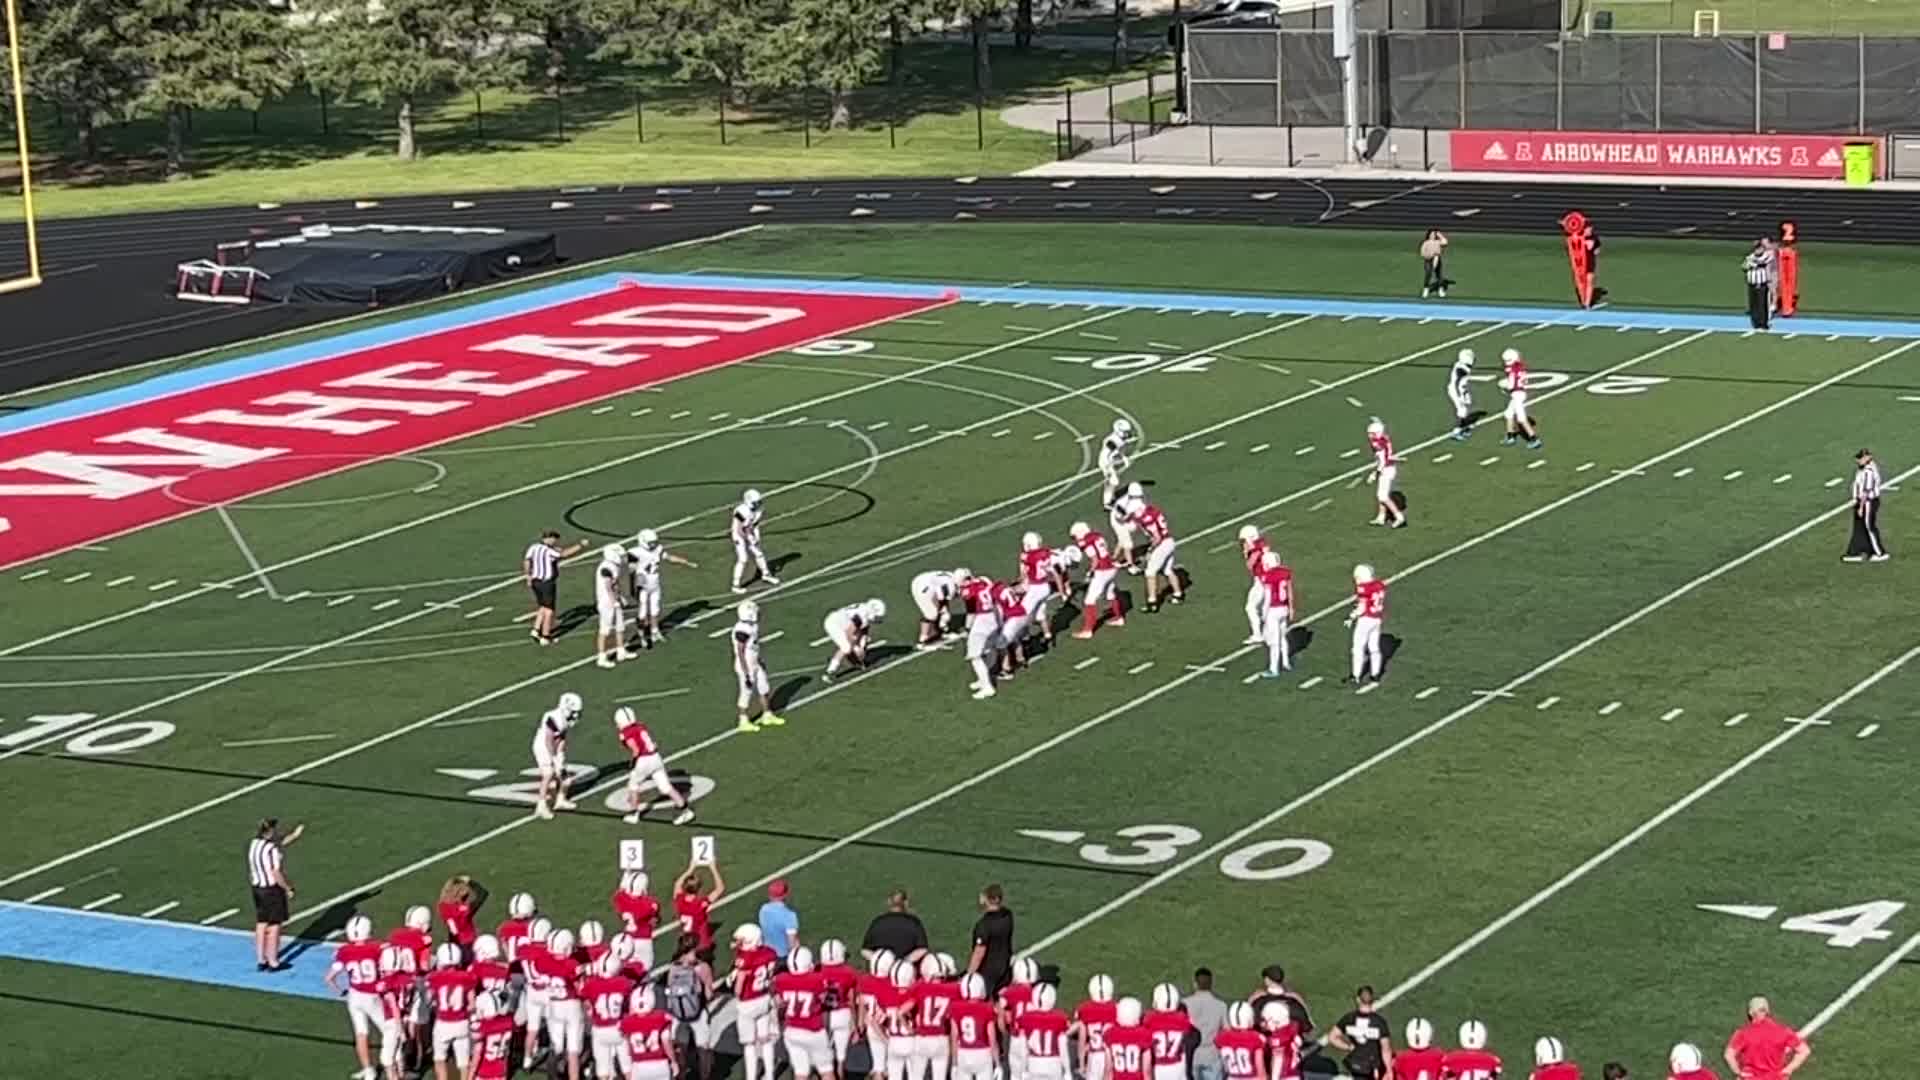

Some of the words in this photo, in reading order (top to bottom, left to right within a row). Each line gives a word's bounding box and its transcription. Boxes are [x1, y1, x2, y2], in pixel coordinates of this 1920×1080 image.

[1541, 142, 1658, 164] ARROWHEAD
[1666, 144, 1783, 166] WARHAWKS
[1781, 221, 1796, 241] 2
[0, 712, 177, 755] 10
[466, 763, 716, 812] 20
[626, 846, 638, 862] 3
[697, 839, 709, 861] 2
[1079, 823, 1334, 881] 30
[345, 958, 377, 985] 39
[438, 984, 465, 1012] 14
[595, 992, 625, 1020] 46
[782, 990, 815, 1018] 77
[923, 996, 950, 1027] 17
[960, 1015, 977, 1044] 9
[1027, 1028, 1051, 1056] 41
[1111, 1043, 1139, 1073] 60
[1152, 1030, 1181, 1058] 37
[1220, 1046, 1253, 1075] 20
